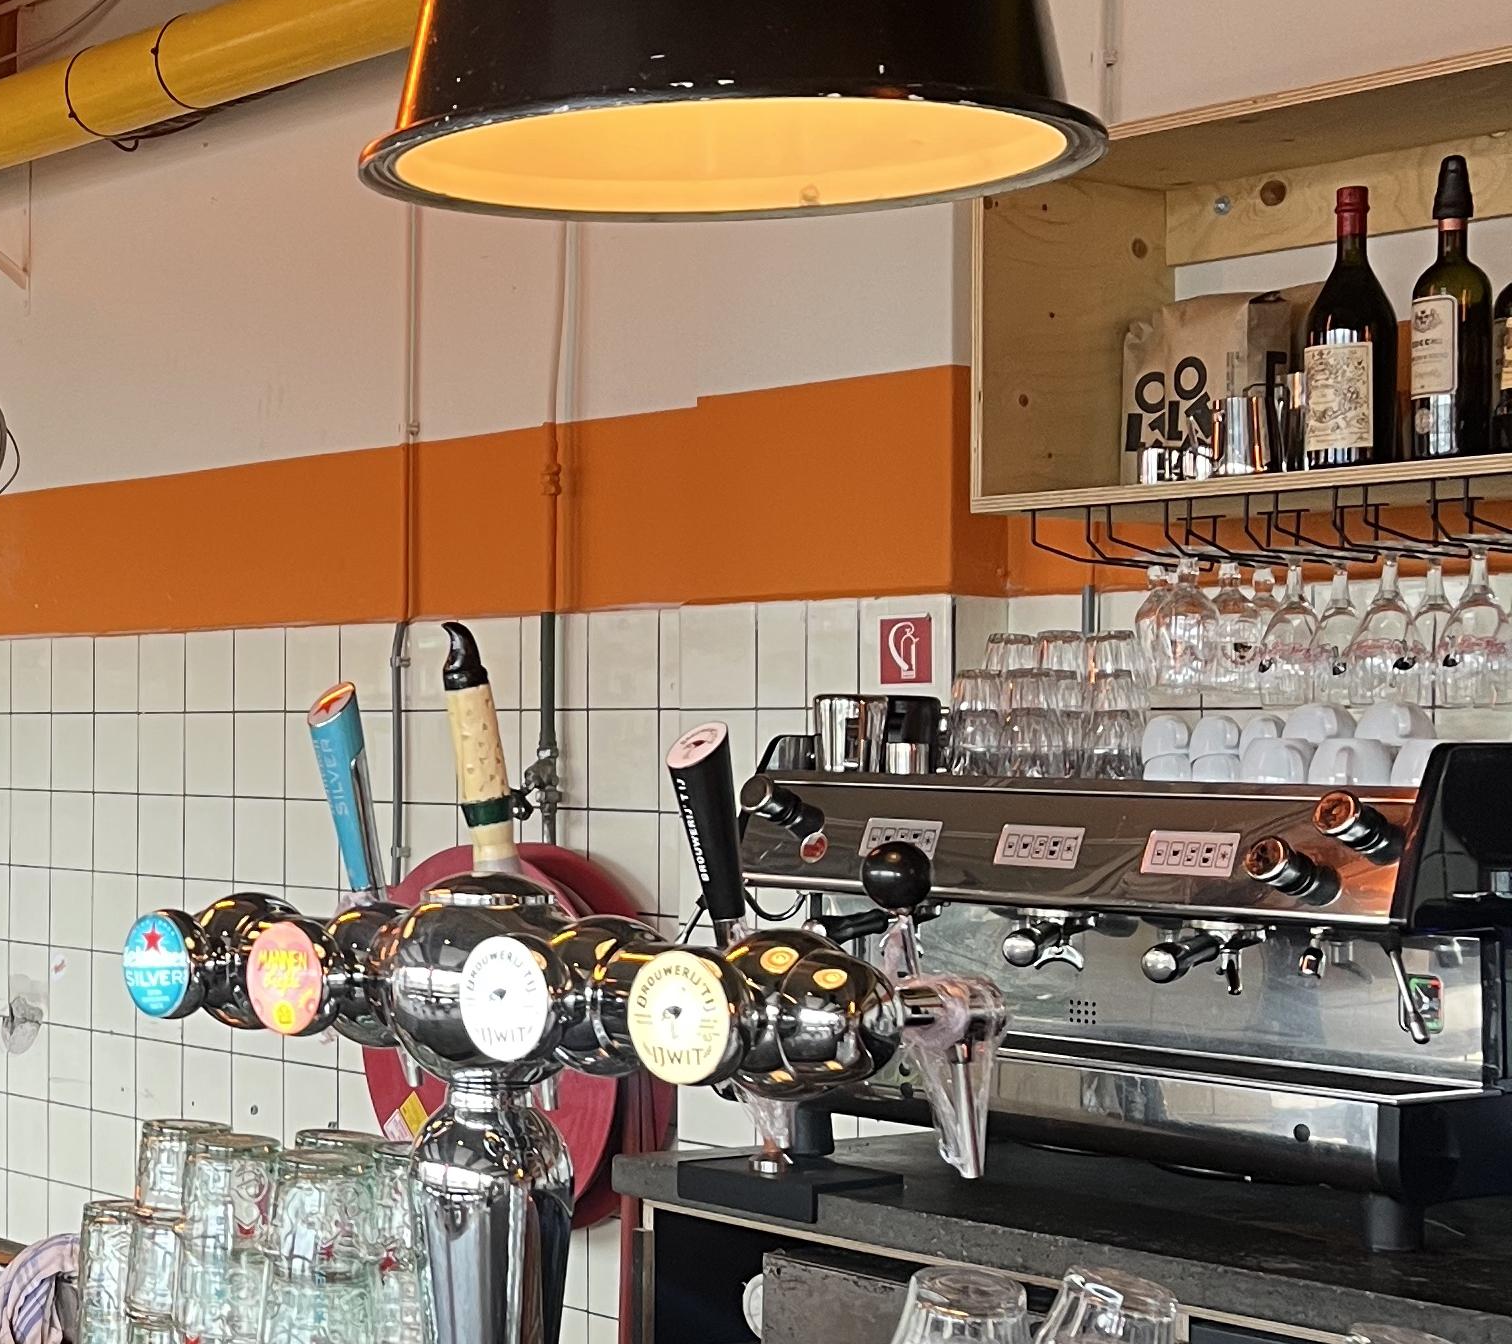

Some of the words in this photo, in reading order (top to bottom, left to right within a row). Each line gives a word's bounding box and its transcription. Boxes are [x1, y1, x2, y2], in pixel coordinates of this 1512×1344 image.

[320, 738, 350, 816] SILVER
[126, 969, 184, 987] SILVER
[481, 1027, 526, 1046] IJWIT
[652, 1045, 704, 1067] IJWIT
